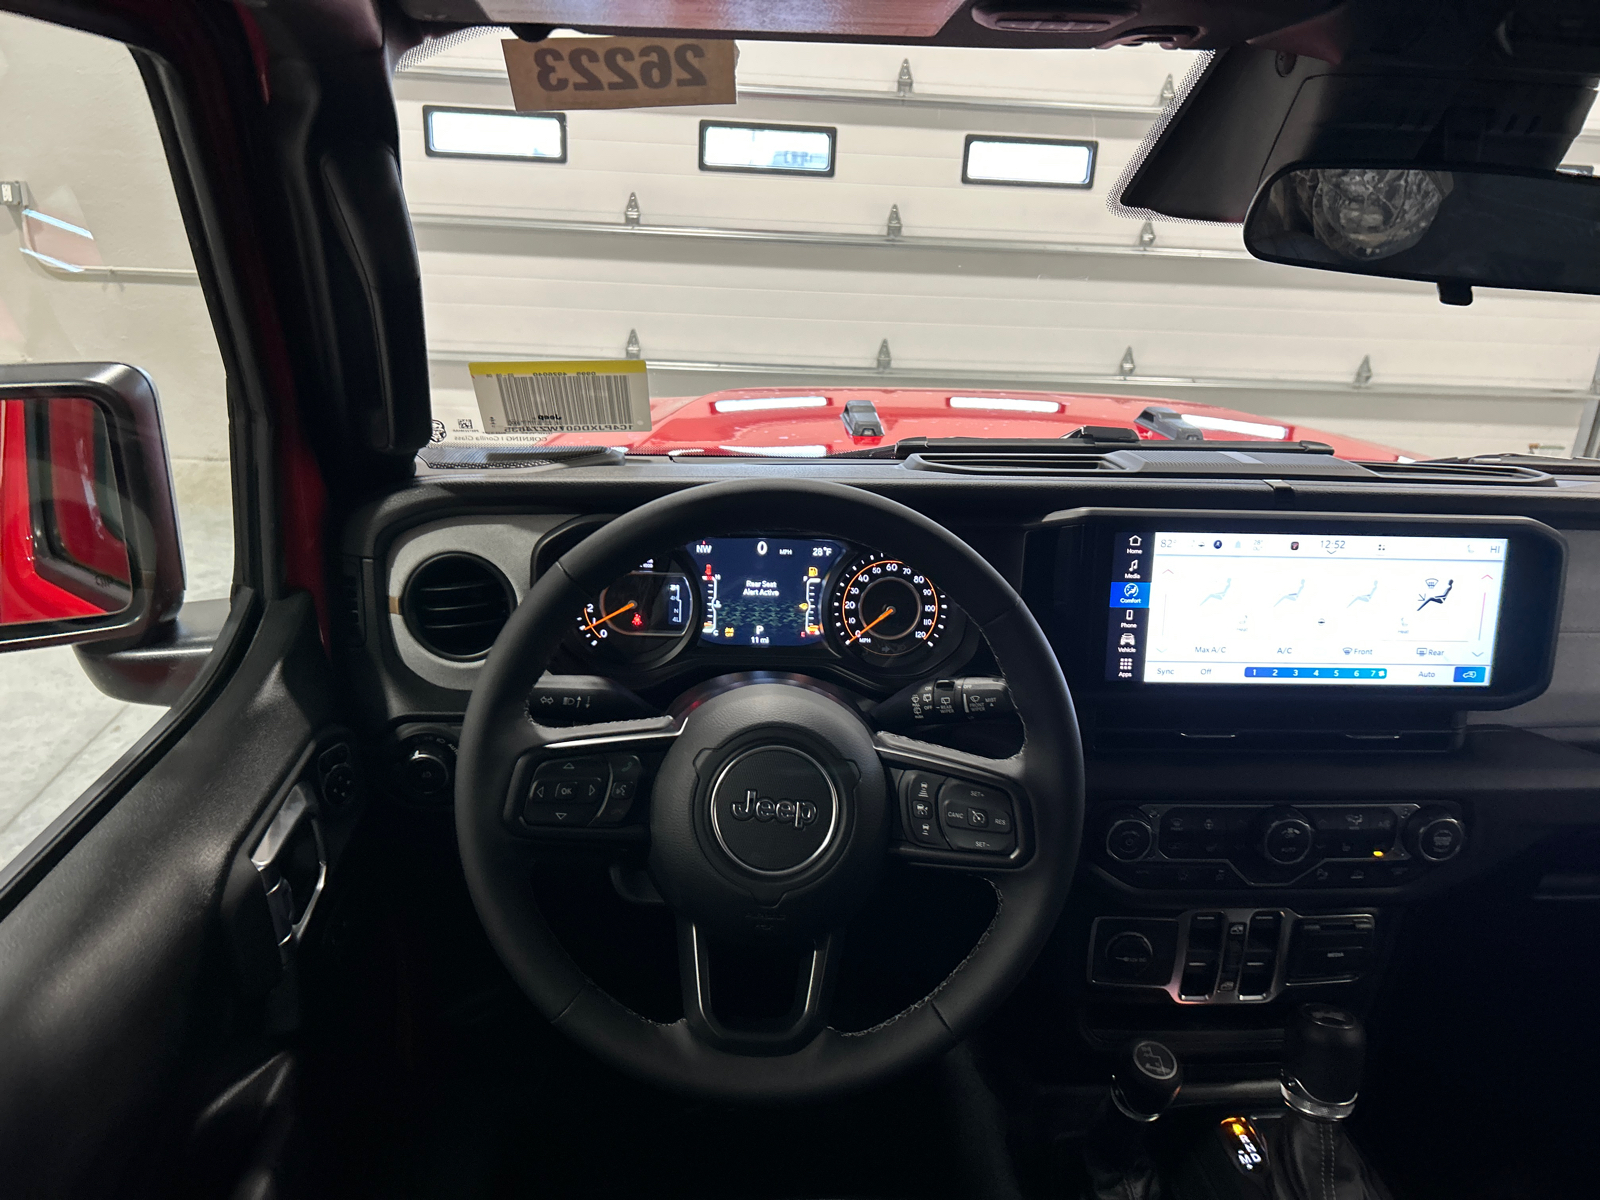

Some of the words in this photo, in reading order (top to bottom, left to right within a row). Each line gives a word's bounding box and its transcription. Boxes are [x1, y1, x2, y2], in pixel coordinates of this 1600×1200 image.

[757, 541, 768, 555] 0
[1320, 540, 1346, 549] 12:52
[696, 545, 712, 554] NW
[1490, 546, 1500, 554] HI
[886, 564, 898, 572] 60
[858, 574, 870, 582] 40
[914, 576, 924, 584] 80
[746, 580, 761, 588] Rear
[762, 580, 777, 588] Seat
[743, 588, 759, 596] Alert
[759, 588, 780, 596] Active
[923, 588, 932, 596] 90
[586, 603, 594, 613] 2
[845, 601, 856, 609] 20
[924, 604, 936, 612] 100
[923, 618, 932, 626] 110
[600, 629, 608, 638] 0
[756, 625, 764, 635] P
[751, 636, 759, 644] 11
[760, 636, 770, 644] mi
[1118, 646, 1136, 654] Vehicle
[1211, 646, 1226, 654] A/C
[1157, 668, 1174, 676] Sync
[731, 790, 818, 829] Jeep
[948, 812, 964, 820] CANC
[994, 818, 1006, 826] RES
[1239, 1134, 1250, 1144] R
[1244, 1144, 1257, 1152] N
[1238, 1154, 1252, 1165] M
[1250, 1153, 1262, 1162] D
